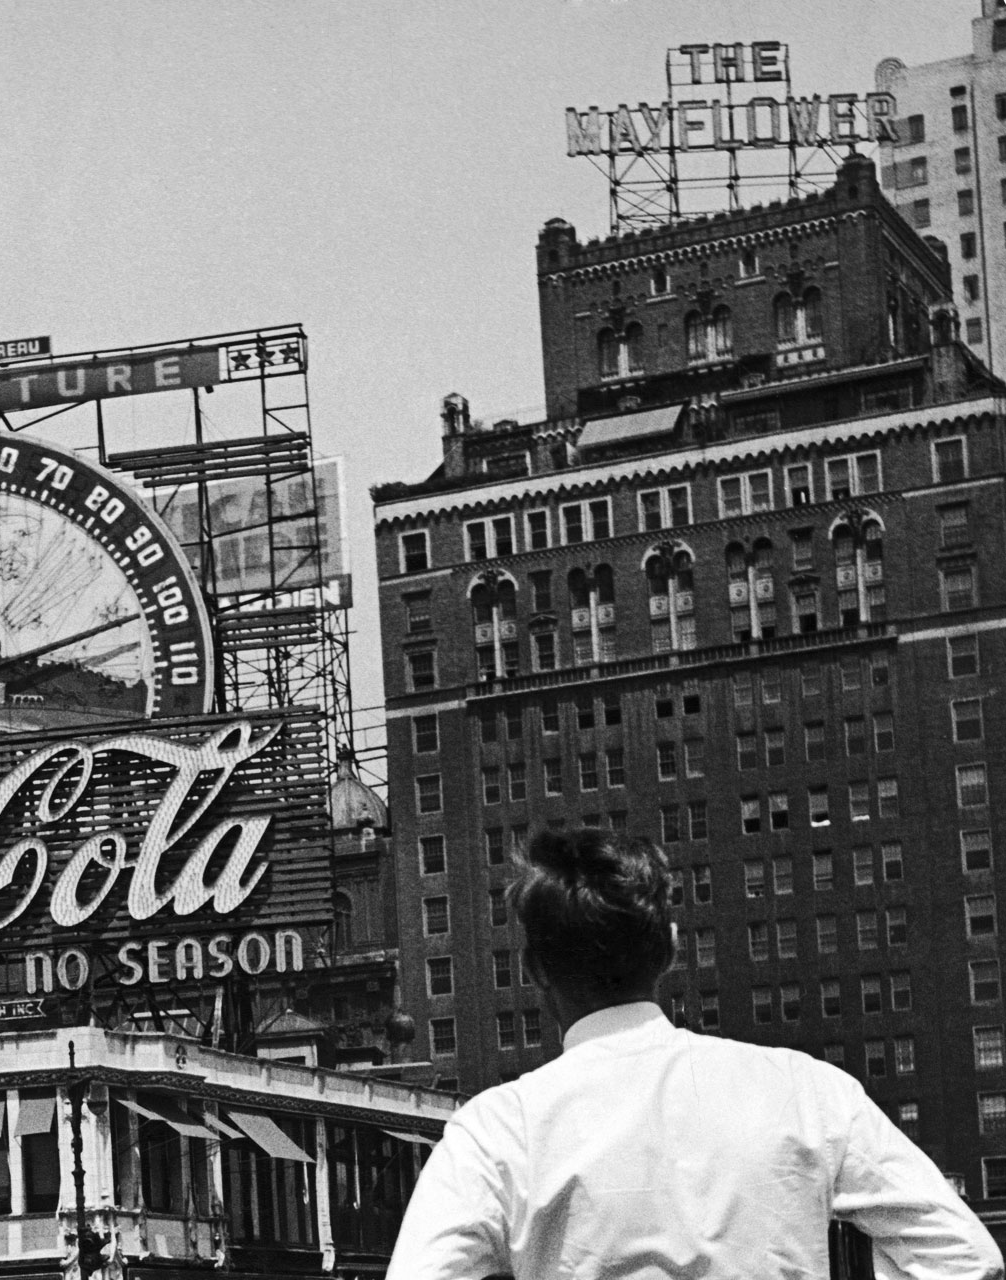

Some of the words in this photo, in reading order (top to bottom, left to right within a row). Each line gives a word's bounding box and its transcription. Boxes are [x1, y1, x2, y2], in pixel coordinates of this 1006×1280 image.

[680, 41, 783, 84] THE
[566, 92, 898, 157] MAYFLOWER
[38, 457, 74, 491] 70
[84, 486, 126, 526] 80
[125, 526, 165, 569] 90
[151, 574, 190, 628] 100
[170, 639, 199, 687] 110
[24, 948, 90, 995] NO
[116, 927, 304, 987] SEASON
[12, 1002, 34, 1016] INC
